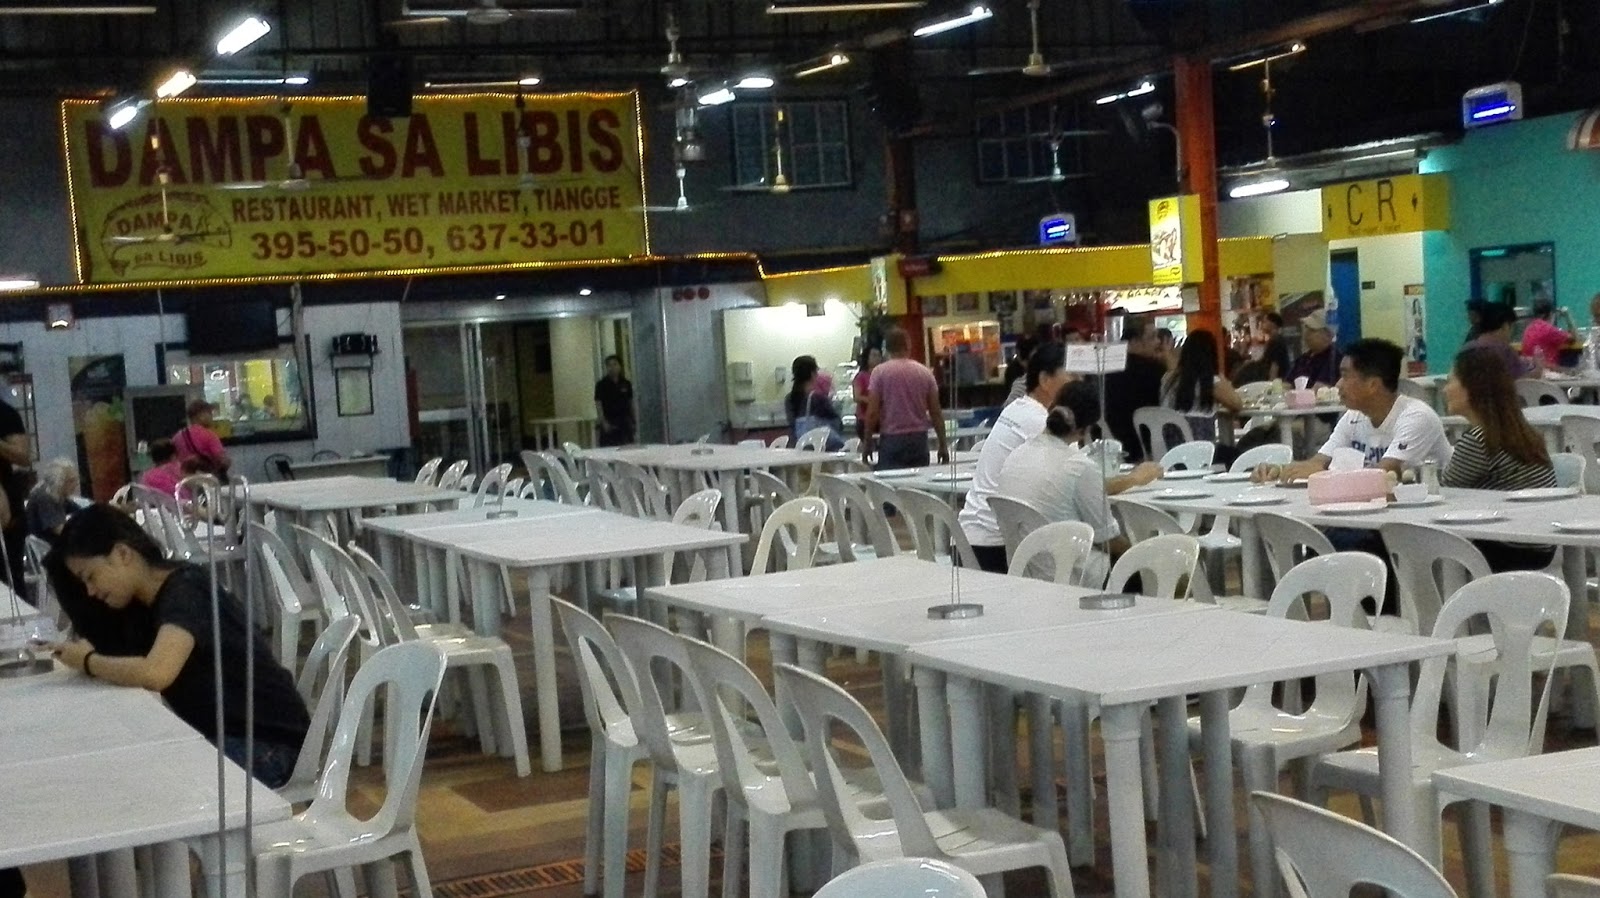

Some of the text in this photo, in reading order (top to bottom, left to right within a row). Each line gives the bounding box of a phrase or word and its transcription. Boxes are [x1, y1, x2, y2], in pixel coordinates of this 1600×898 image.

[85, 108, 623, 188] DAMPA SA LIBIS
[232, 194, 382, 223] RESTAURANT,
[387, 193, 432, 218] WET
[438, 190, 529, 217] MARKET,
[534, 186, 620, 212] TIANGGE
[116, 212, 193, 235] DAMPA
[251, 219, 604, 260] 395-50-50, 637-33-01
[159, 250, 204, 266] LIBIS
